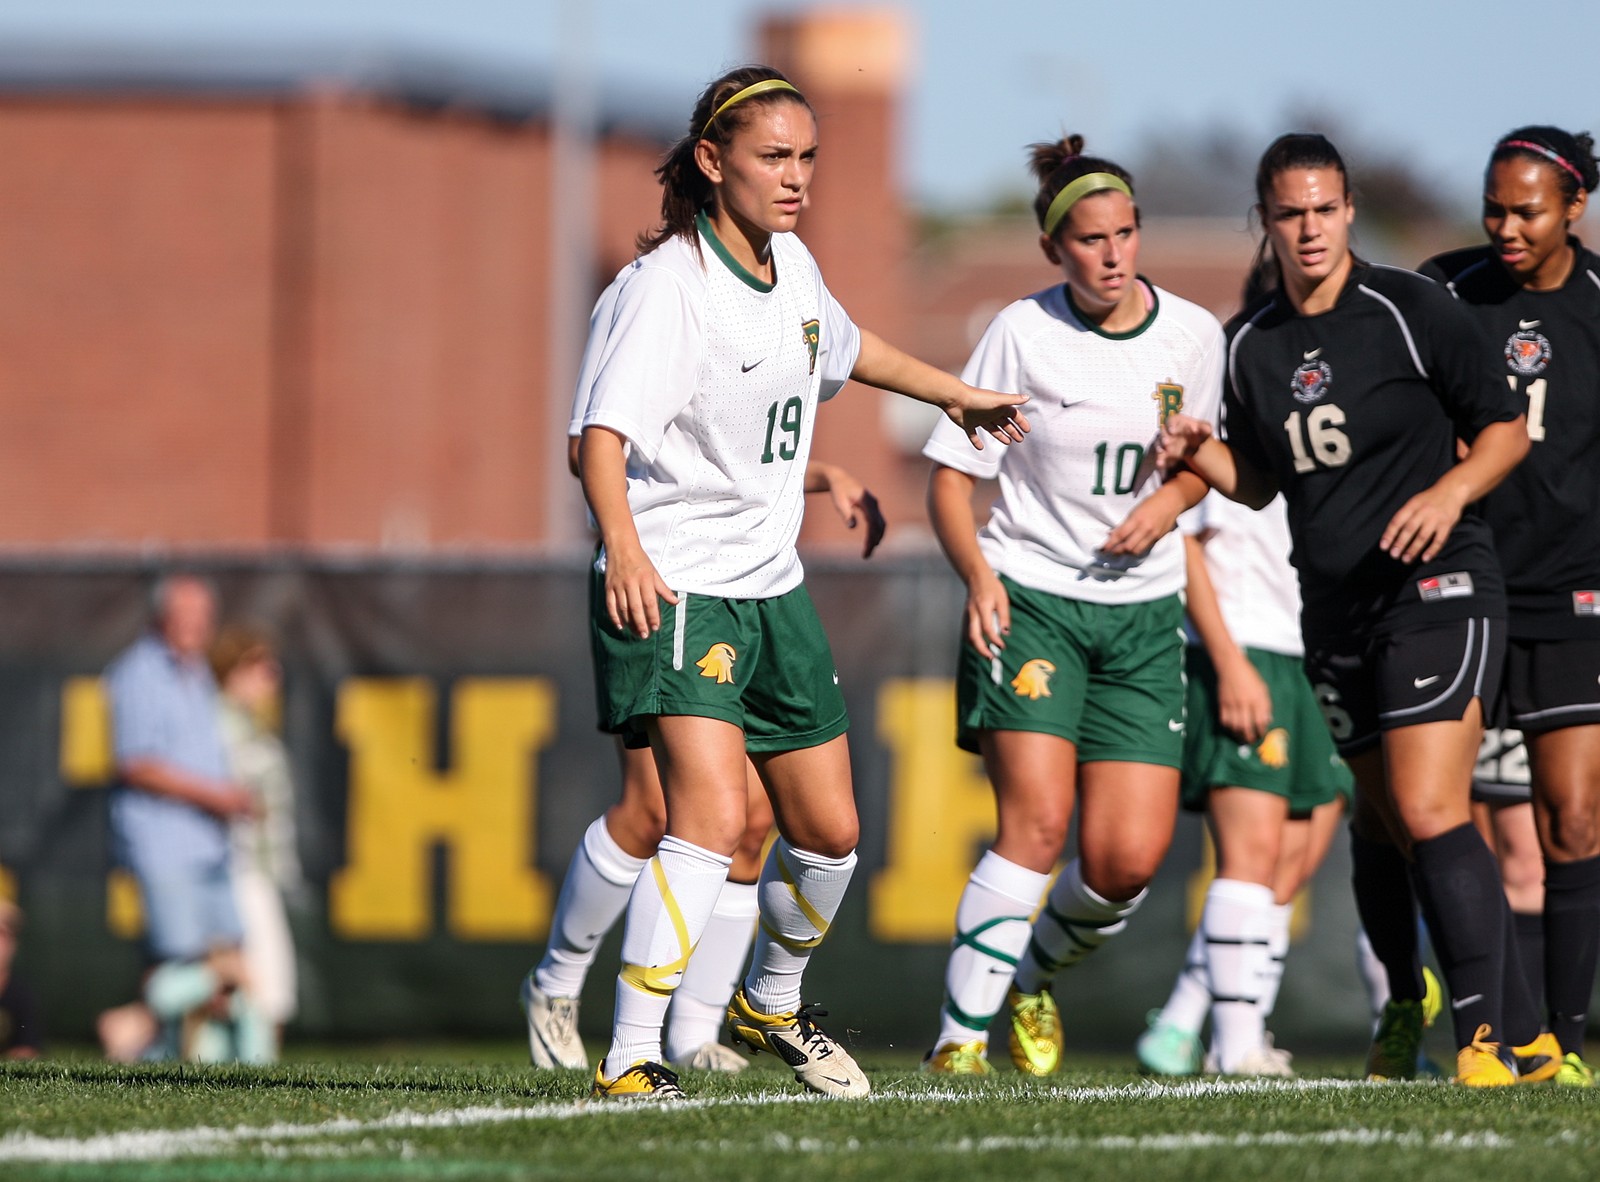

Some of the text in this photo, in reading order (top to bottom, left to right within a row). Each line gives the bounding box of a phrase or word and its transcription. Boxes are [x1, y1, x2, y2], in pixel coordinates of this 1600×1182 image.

[761, 396, 802, 464] 19
[1284, 403, 1352, 474] 16
[1091, 441, 1145, 495] 10
[1473, 728, 1532, 784] 22
